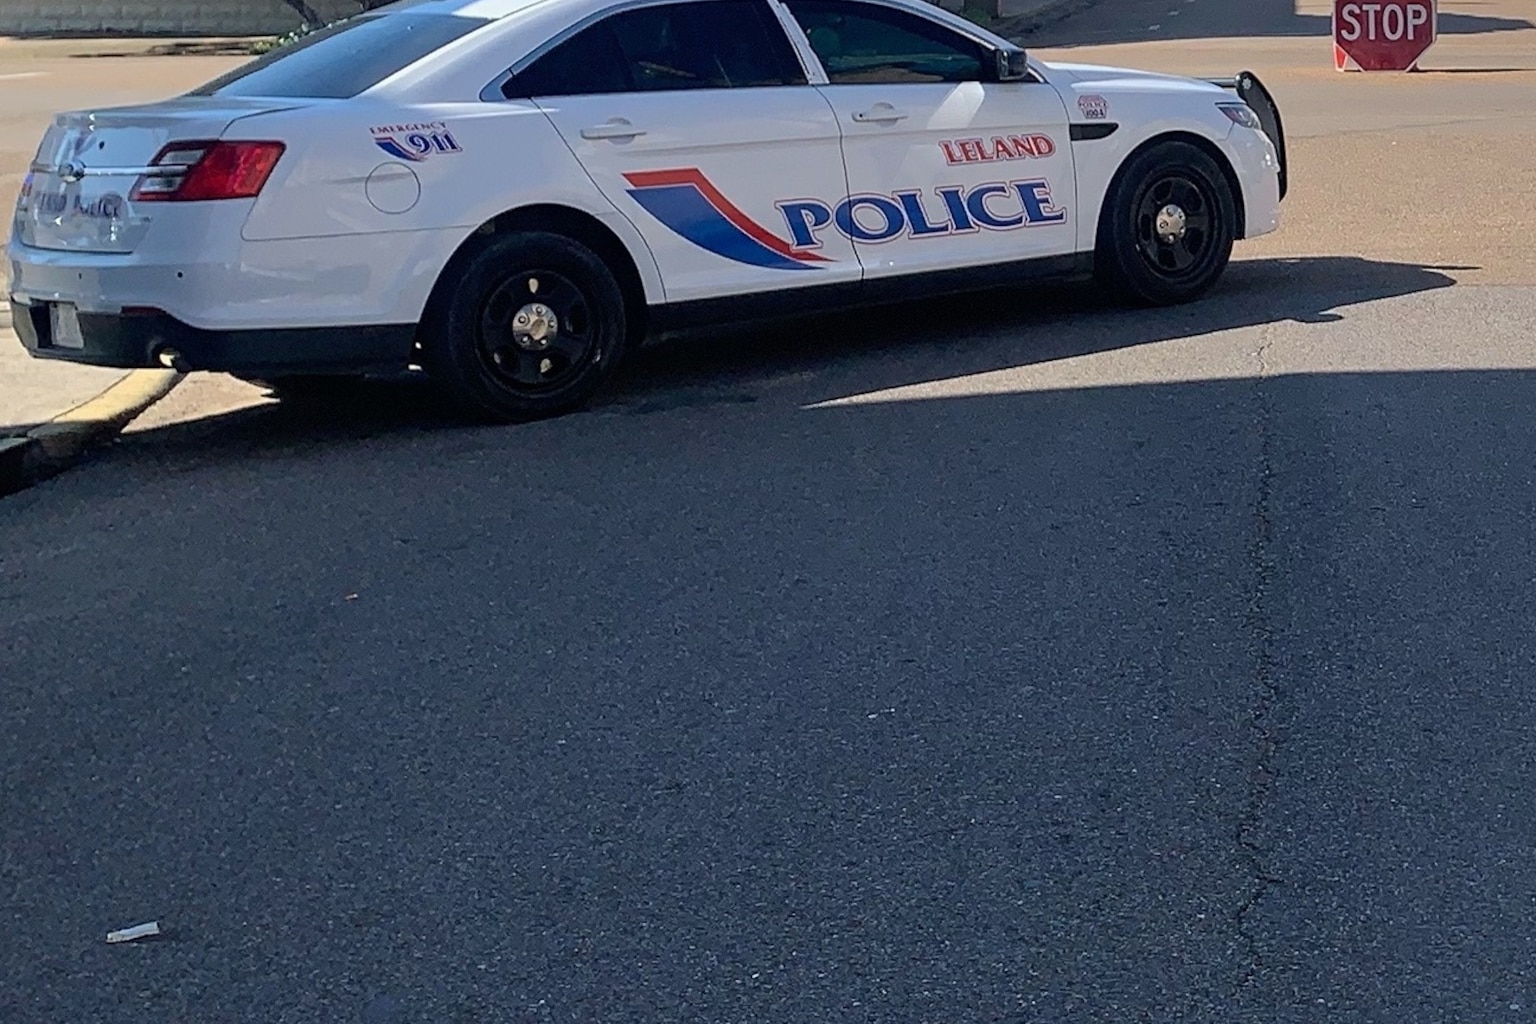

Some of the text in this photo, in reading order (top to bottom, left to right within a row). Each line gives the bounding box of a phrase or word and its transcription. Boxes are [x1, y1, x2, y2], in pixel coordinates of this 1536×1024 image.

[1341, 3, 1428, 41] STOP
[369, 122, 446, 134] EMERGENCY
[405, 131, 462, 155] 911
[939, 133, 1056, 165] LELAND
[774, 177, 1067, 251] POLICE
